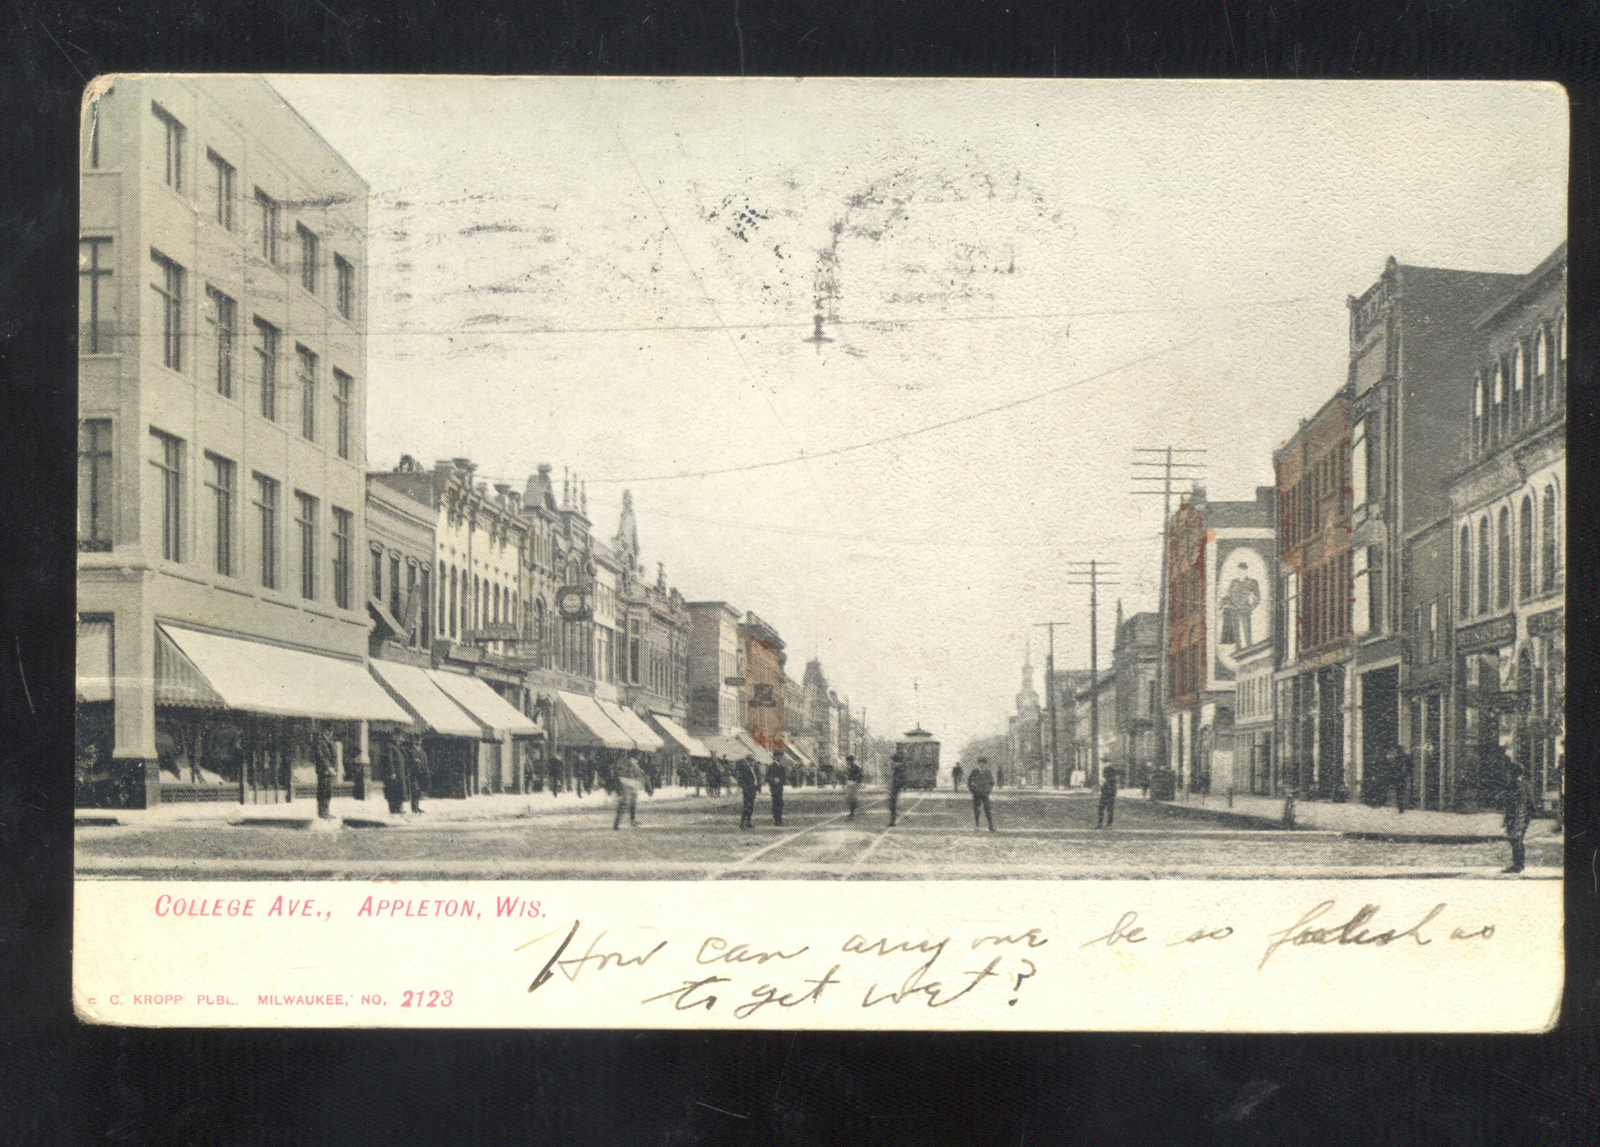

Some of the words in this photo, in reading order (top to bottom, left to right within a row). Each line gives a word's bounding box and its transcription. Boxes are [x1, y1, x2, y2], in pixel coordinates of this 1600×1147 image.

[357, 895, 482, 920] APPLETON,
[496, 896, 548, 918] WIS.
[515, 919, 668, 993] How
[696, 936, 810, 966] can
[841, 933, 946, 988] any
[971, 926, 1049, 949] one
[1080, 910, 1148, 948] be
[1167, 925, 1234, 947] so
[1258, 899, 1446, 972] foolish
[1449, 924, 1496, 942] as
[133, 994, 184, 1006] KROPP
[257, 994, 349, 1007] MILWAUKEE,
[400, 989, 454, 1008] 2123
[641, 975, 733, 1012] to
[733, 963, 842, 1021] get
